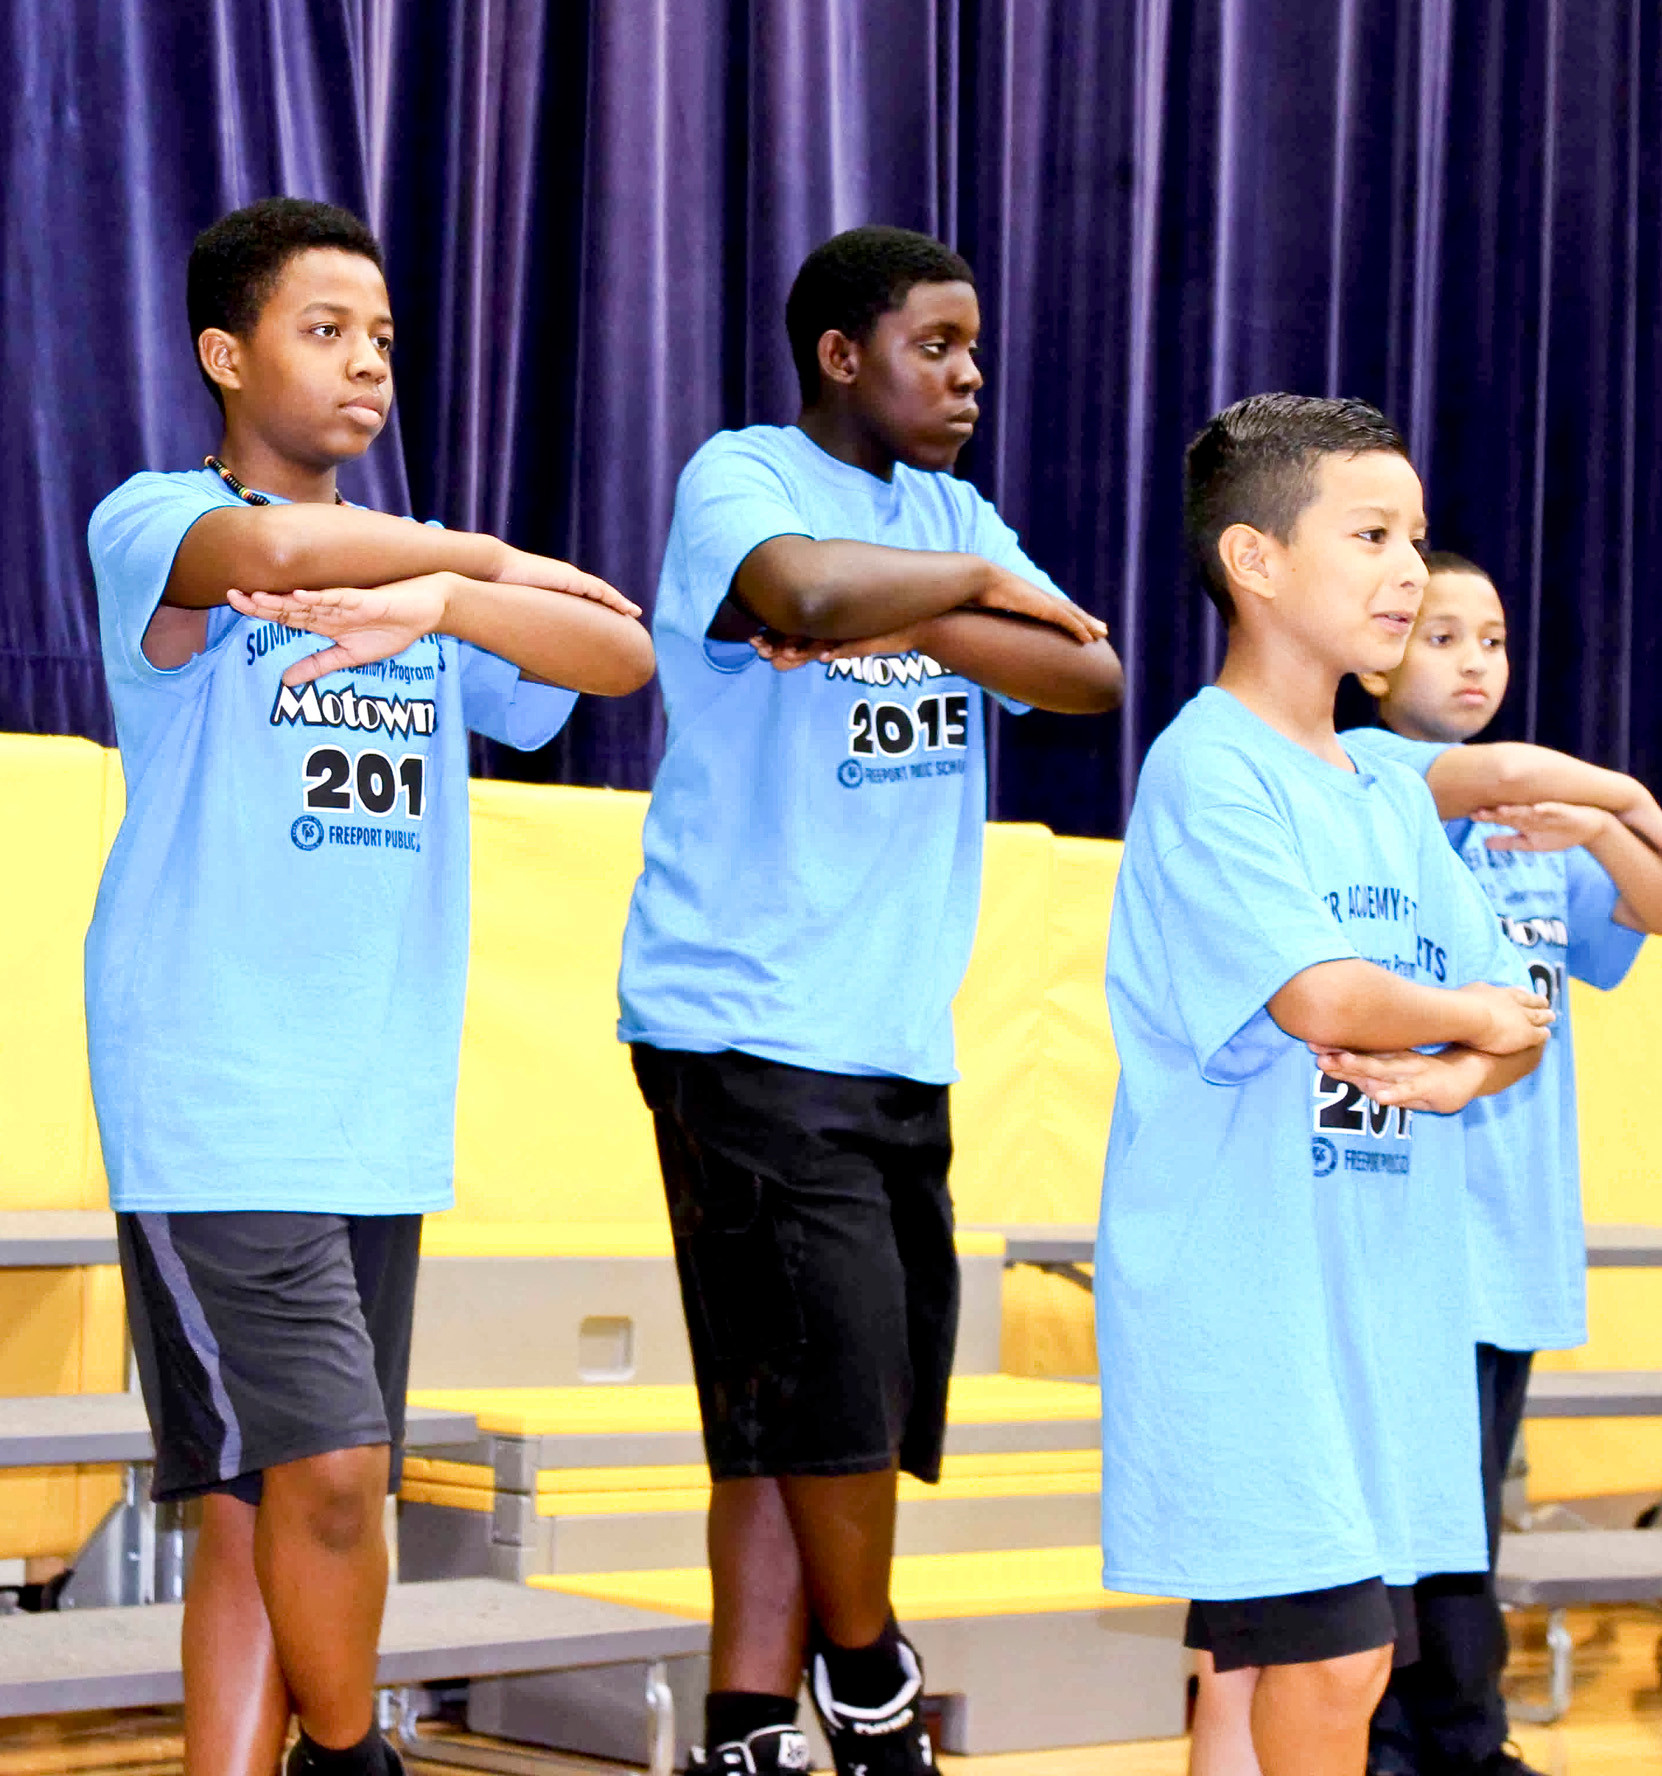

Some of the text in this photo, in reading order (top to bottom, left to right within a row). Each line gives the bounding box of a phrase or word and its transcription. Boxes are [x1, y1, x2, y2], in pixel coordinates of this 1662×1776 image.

[389, 658, 435, 685] Program
[270, 681, 437, 742] Motown
[849, 692, 969, 758] 2015
[302, 743, 426, 820] 201
[329, 825, 382, 847] FREEPORT
[385, 829, 417, 850] PUBLIC
